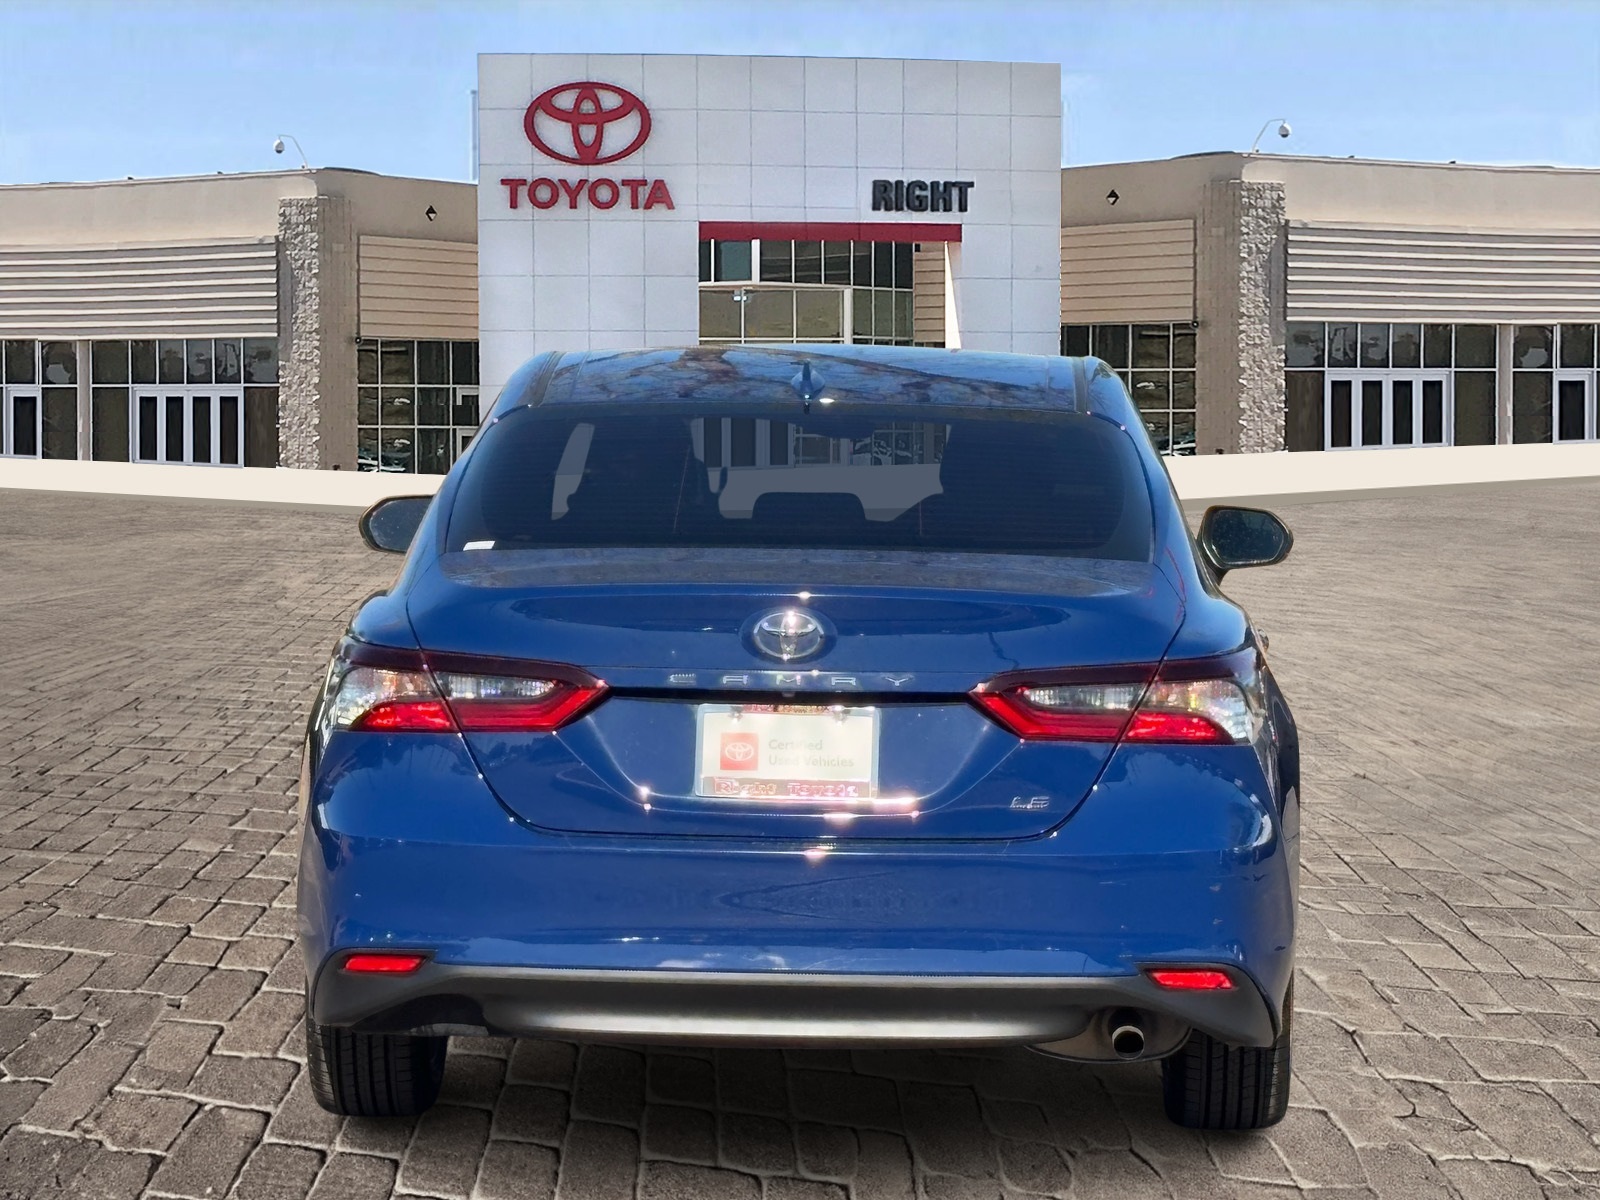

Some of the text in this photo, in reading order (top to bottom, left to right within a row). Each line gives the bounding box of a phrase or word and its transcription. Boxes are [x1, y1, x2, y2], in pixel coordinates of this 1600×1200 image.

[500, 177, 675, 210] TOYOTA
[871, 179, 975, 213] RIGHT
[669, 672, 914, 686] CAMRY
[768, 739, 823, 751] Certed
